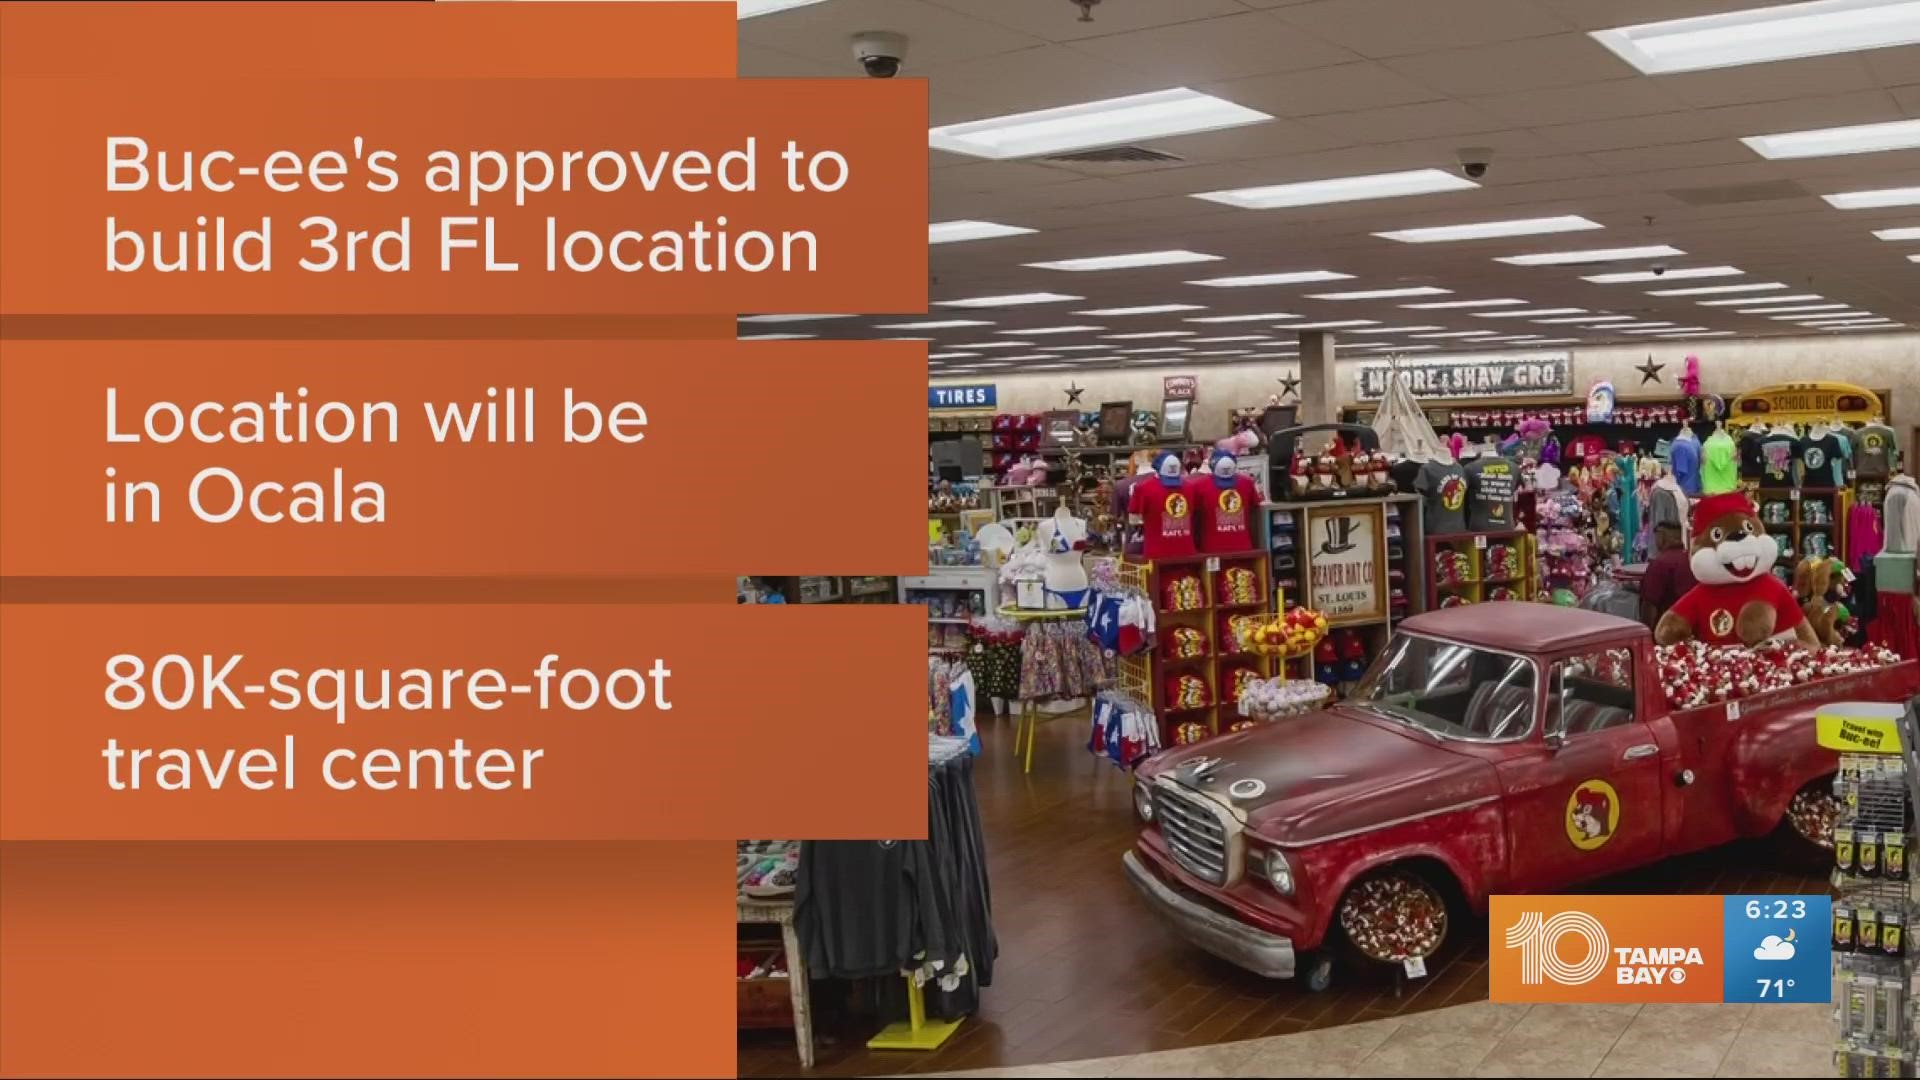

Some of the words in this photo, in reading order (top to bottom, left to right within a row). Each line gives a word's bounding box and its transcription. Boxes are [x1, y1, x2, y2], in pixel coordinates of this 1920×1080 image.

[1453, 366, 1504, 386] SHAW
[936, 388, 985, 404] TIRES
[1773, 394, 1811, 410] SCHOOL
[1815, 394, 1835, 410] BUS
[1312, 563, 1344, 587] BEAVER
[1345, 562, 1360, 585] HAT
[1336, 592, 1367, 602] LOUIS
[1842, 719, 1867, 734] Travel
[1866, 728, 1884, 738] with
